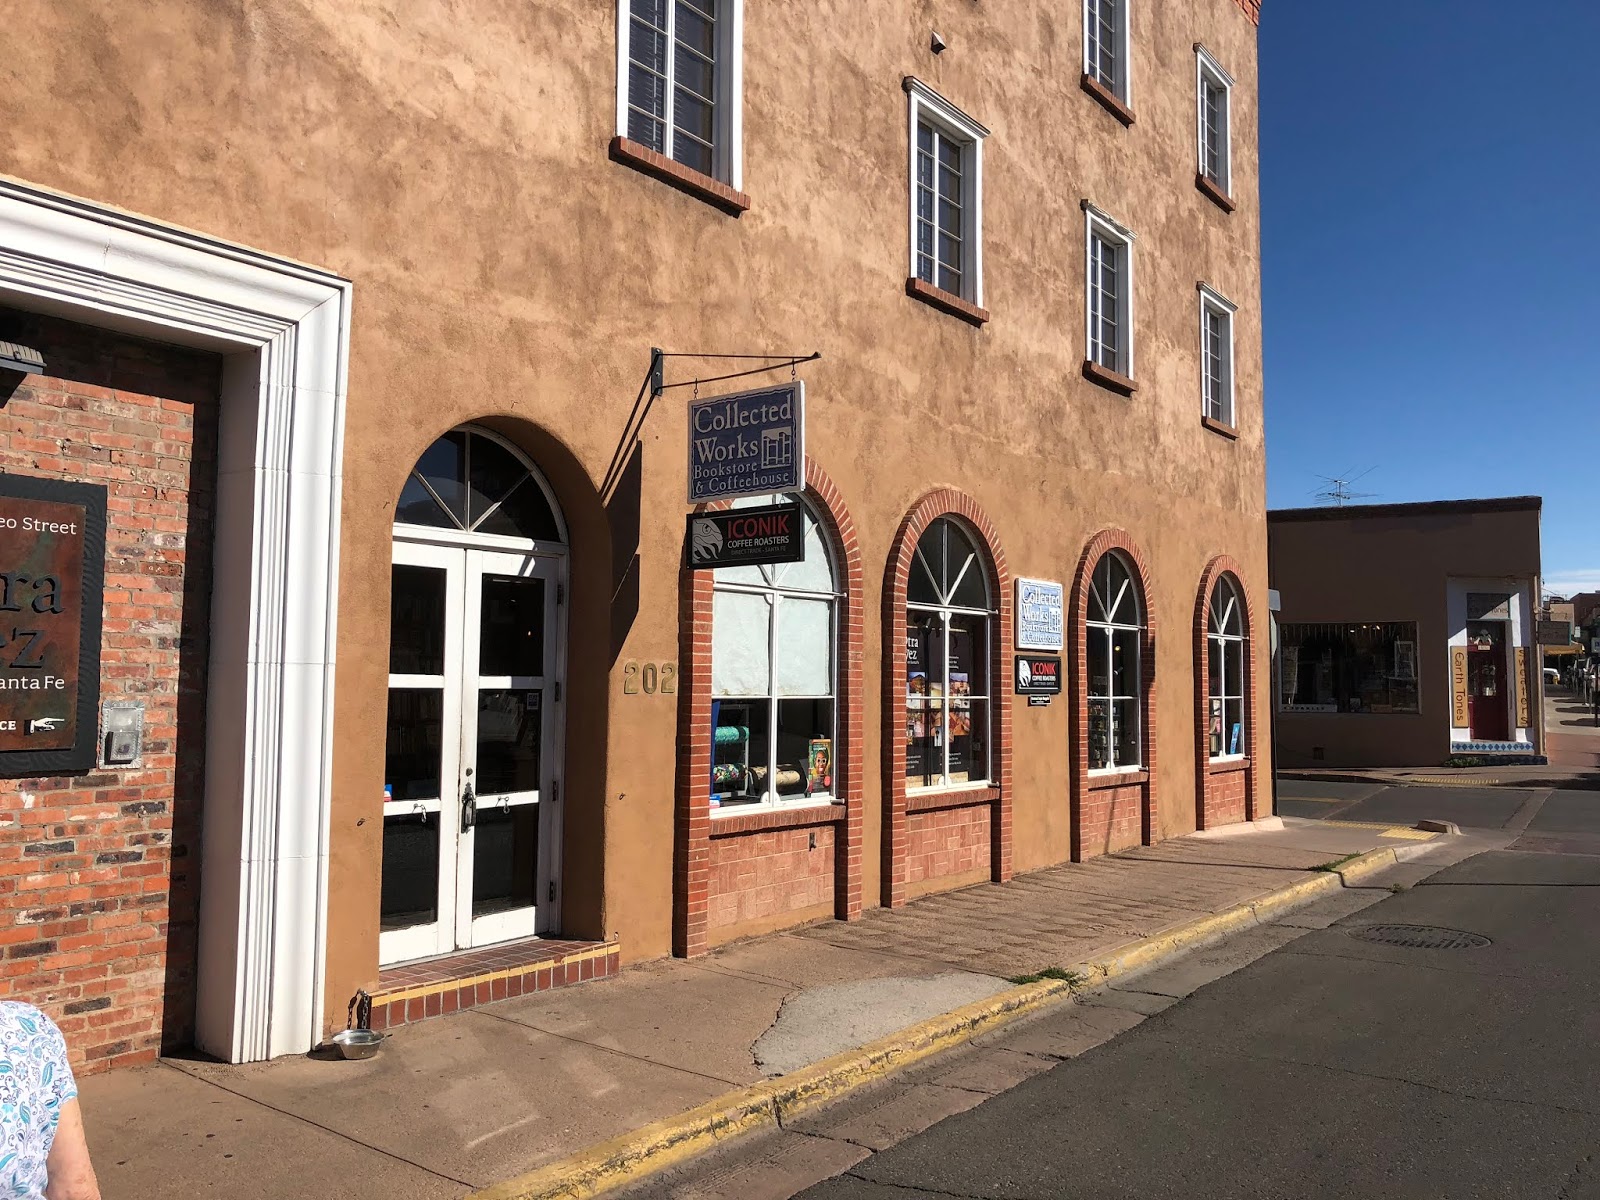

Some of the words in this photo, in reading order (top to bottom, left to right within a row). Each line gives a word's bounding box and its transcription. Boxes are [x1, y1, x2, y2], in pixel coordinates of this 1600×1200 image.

[694, 393, 792, 433] Collected
[694, 433, 759, 464] Works
[694, 461, 758, 480] Bookstore
[695, 479, 704, 494] &
[709, 471, 789, 492] Coffeehouse
[22, 517, 77, 535] Street
[727, 514, 790, 539] ICONIK
[727, 536, 753, 549] COFFEE
[753, 535, 790, 547] ROASTERS
[1022, 585, 1060, 607] Collected
[1022, 603, 1049, 623] Works
[906, 637, 919, 648] tra
[624, 661, 676, 695] 202
[1032, 662, 1056, 675] ICONIK
[1455, 652, 1465, 684] Earth
[44, 675, 65, 690] Fe
[1455, 688, 1465, 721] Tones
